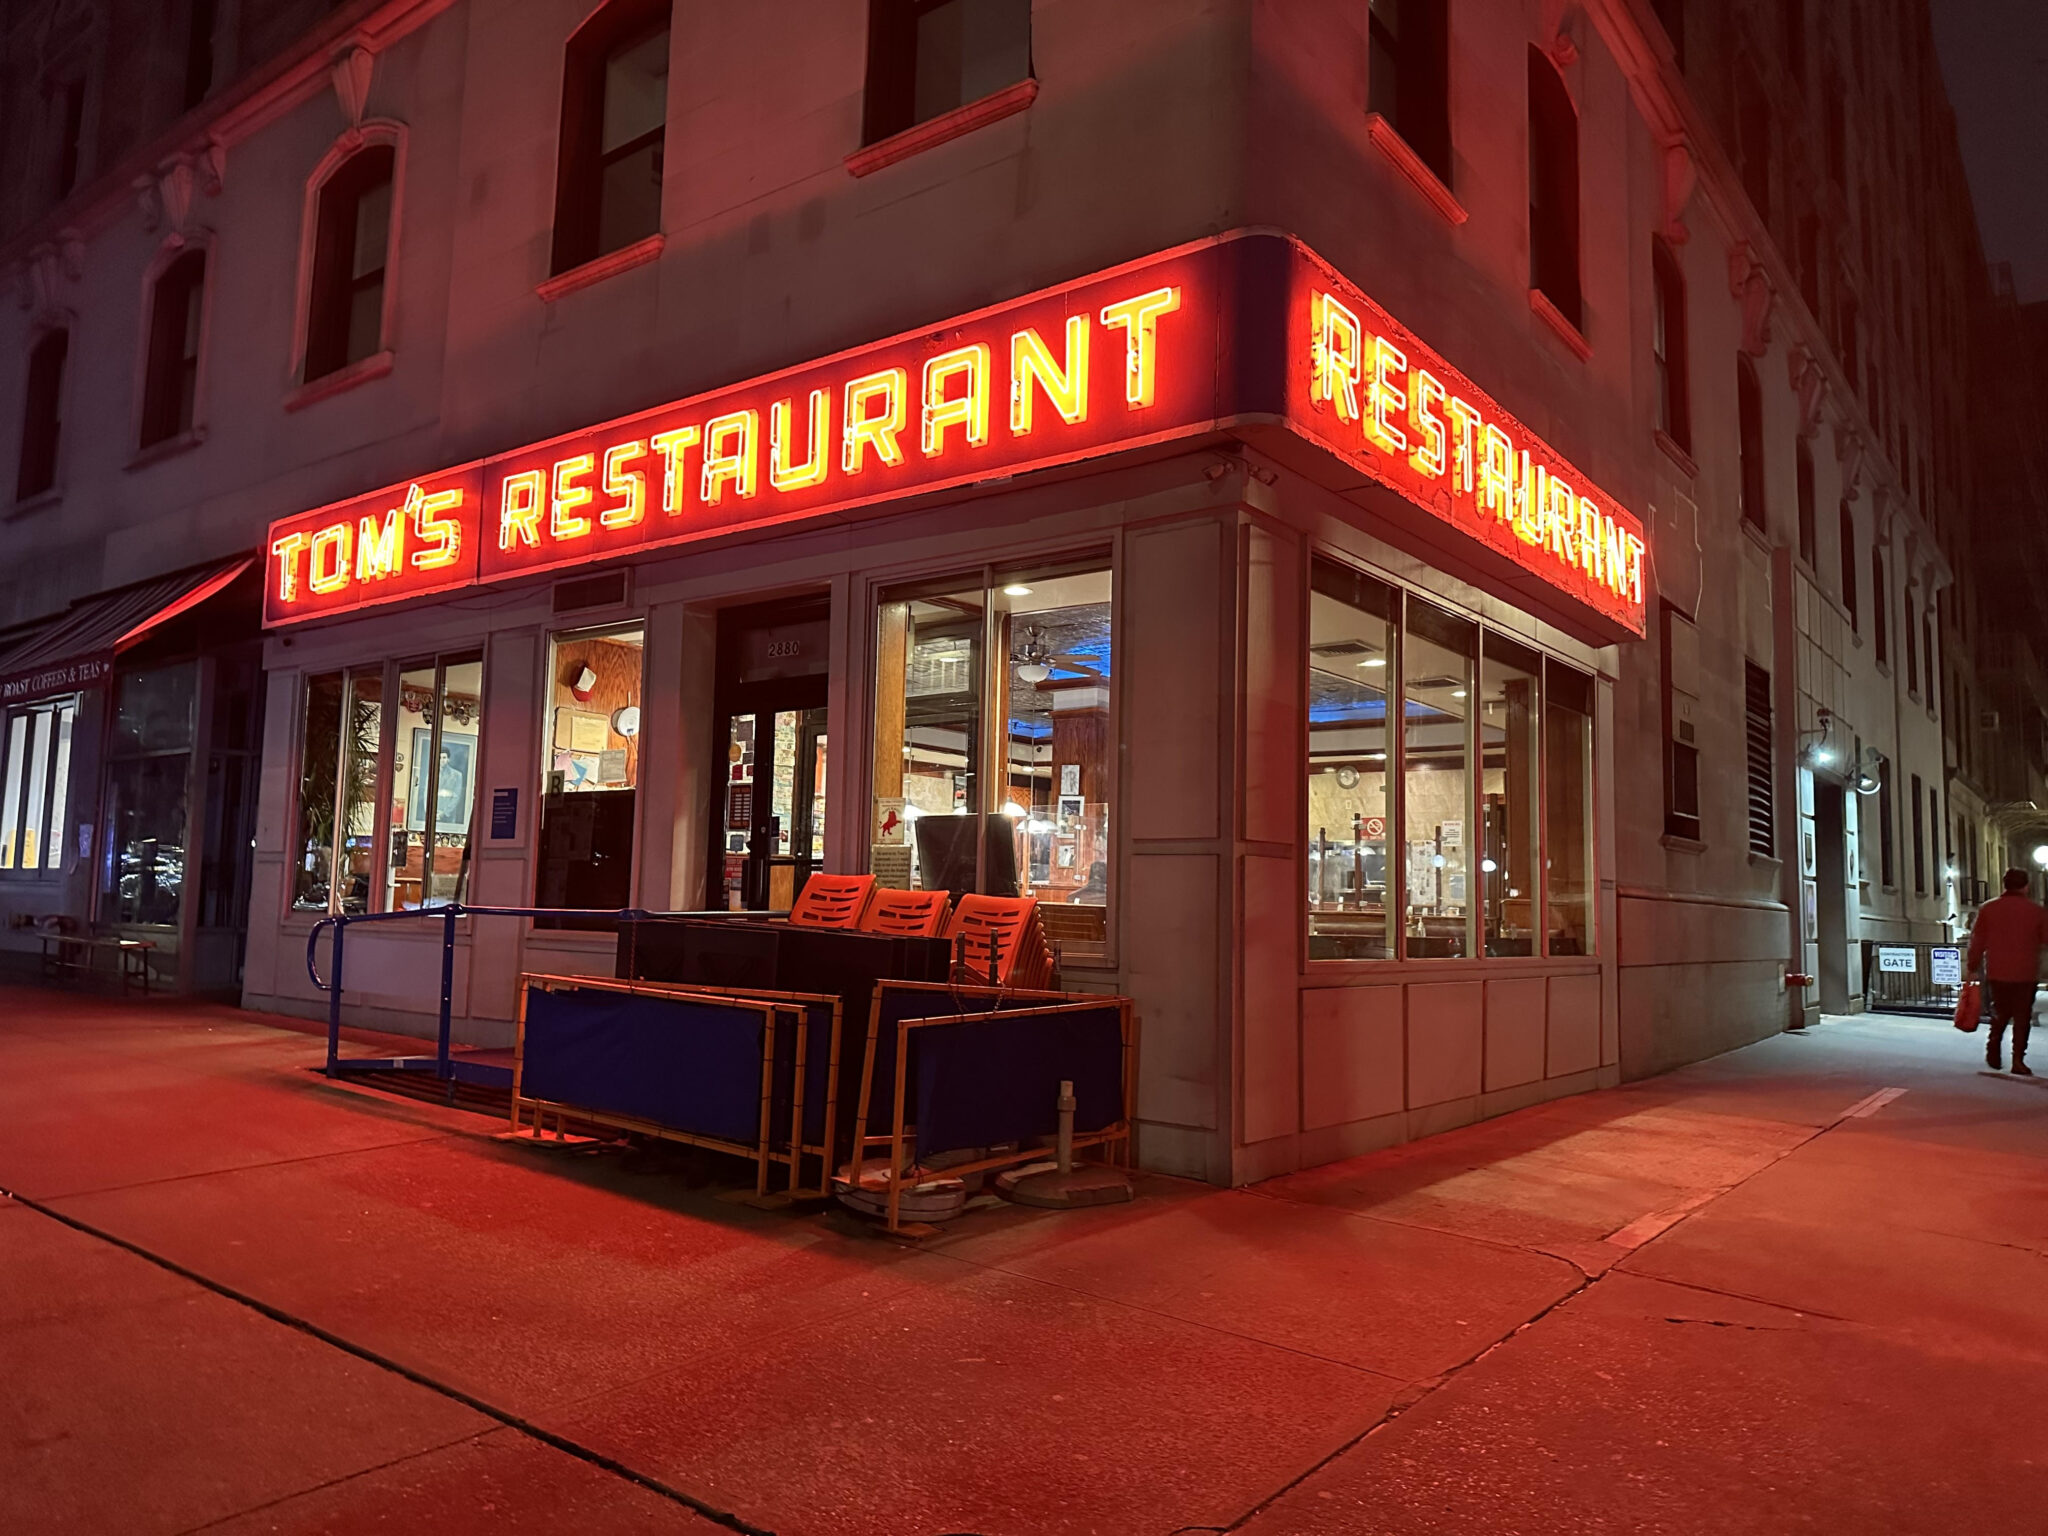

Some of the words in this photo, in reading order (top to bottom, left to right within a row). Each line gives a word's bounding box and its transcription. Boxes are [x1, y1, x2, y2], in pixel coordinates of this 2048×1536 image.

[272, 482, 464, 603] TOM'S
[499, 286, 1181, 554] RESTAURANT
[1311, 289, 1645, 608] RESTAURANT
[769, 641, 799, 656] 2880
[68, 667, 76, 683] &
[79, 660, 101, 681] TEAS
[1883, 959, 1913, 967] GATE
